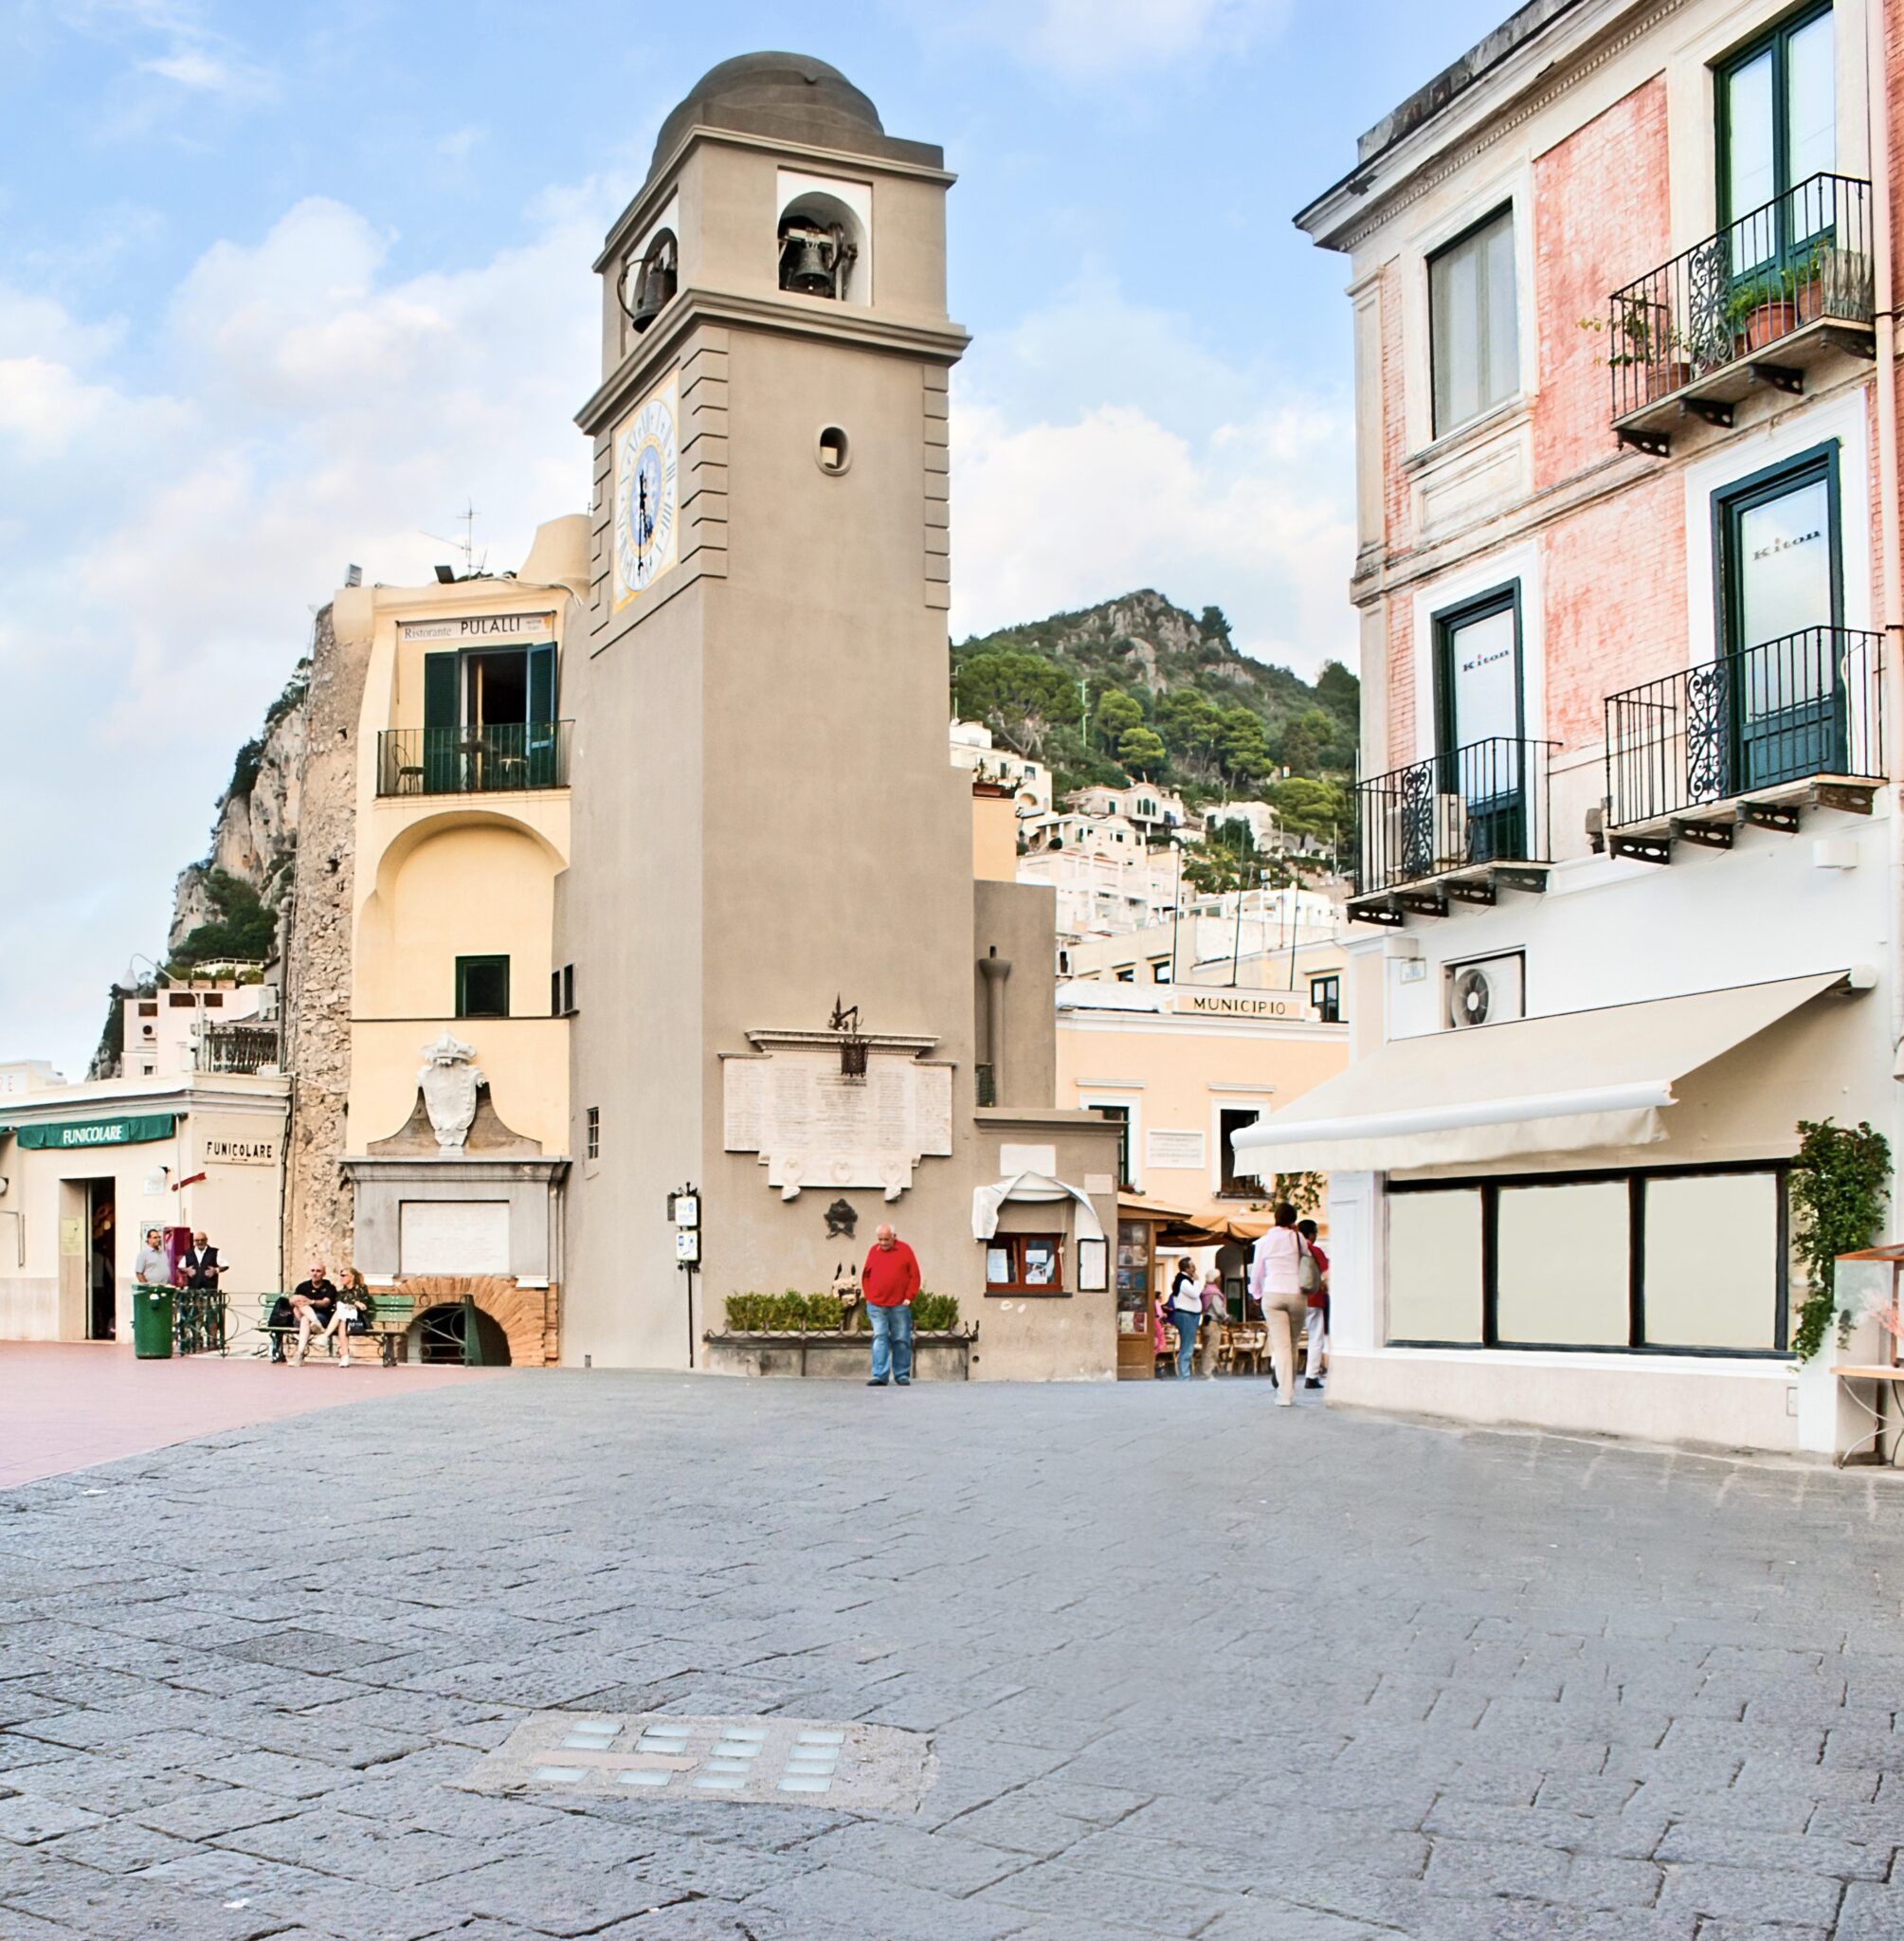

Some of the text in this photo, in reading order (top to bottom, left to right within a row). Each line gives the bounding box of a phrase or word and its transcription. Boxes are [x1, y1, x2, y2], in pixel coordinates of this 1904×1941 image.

[1751, 531, 1821, 561] Kiton
[405, 617, 520, 639] Ristorante PULALLI
[1462, 650, 1509, 672] Kiton
[1193, 997, 1286, 1015] MUNICIPIO
[63, 1125, 122, 1145] FUNICOLARE
[207, 1141, 272, 1158] FUNICOLARE
